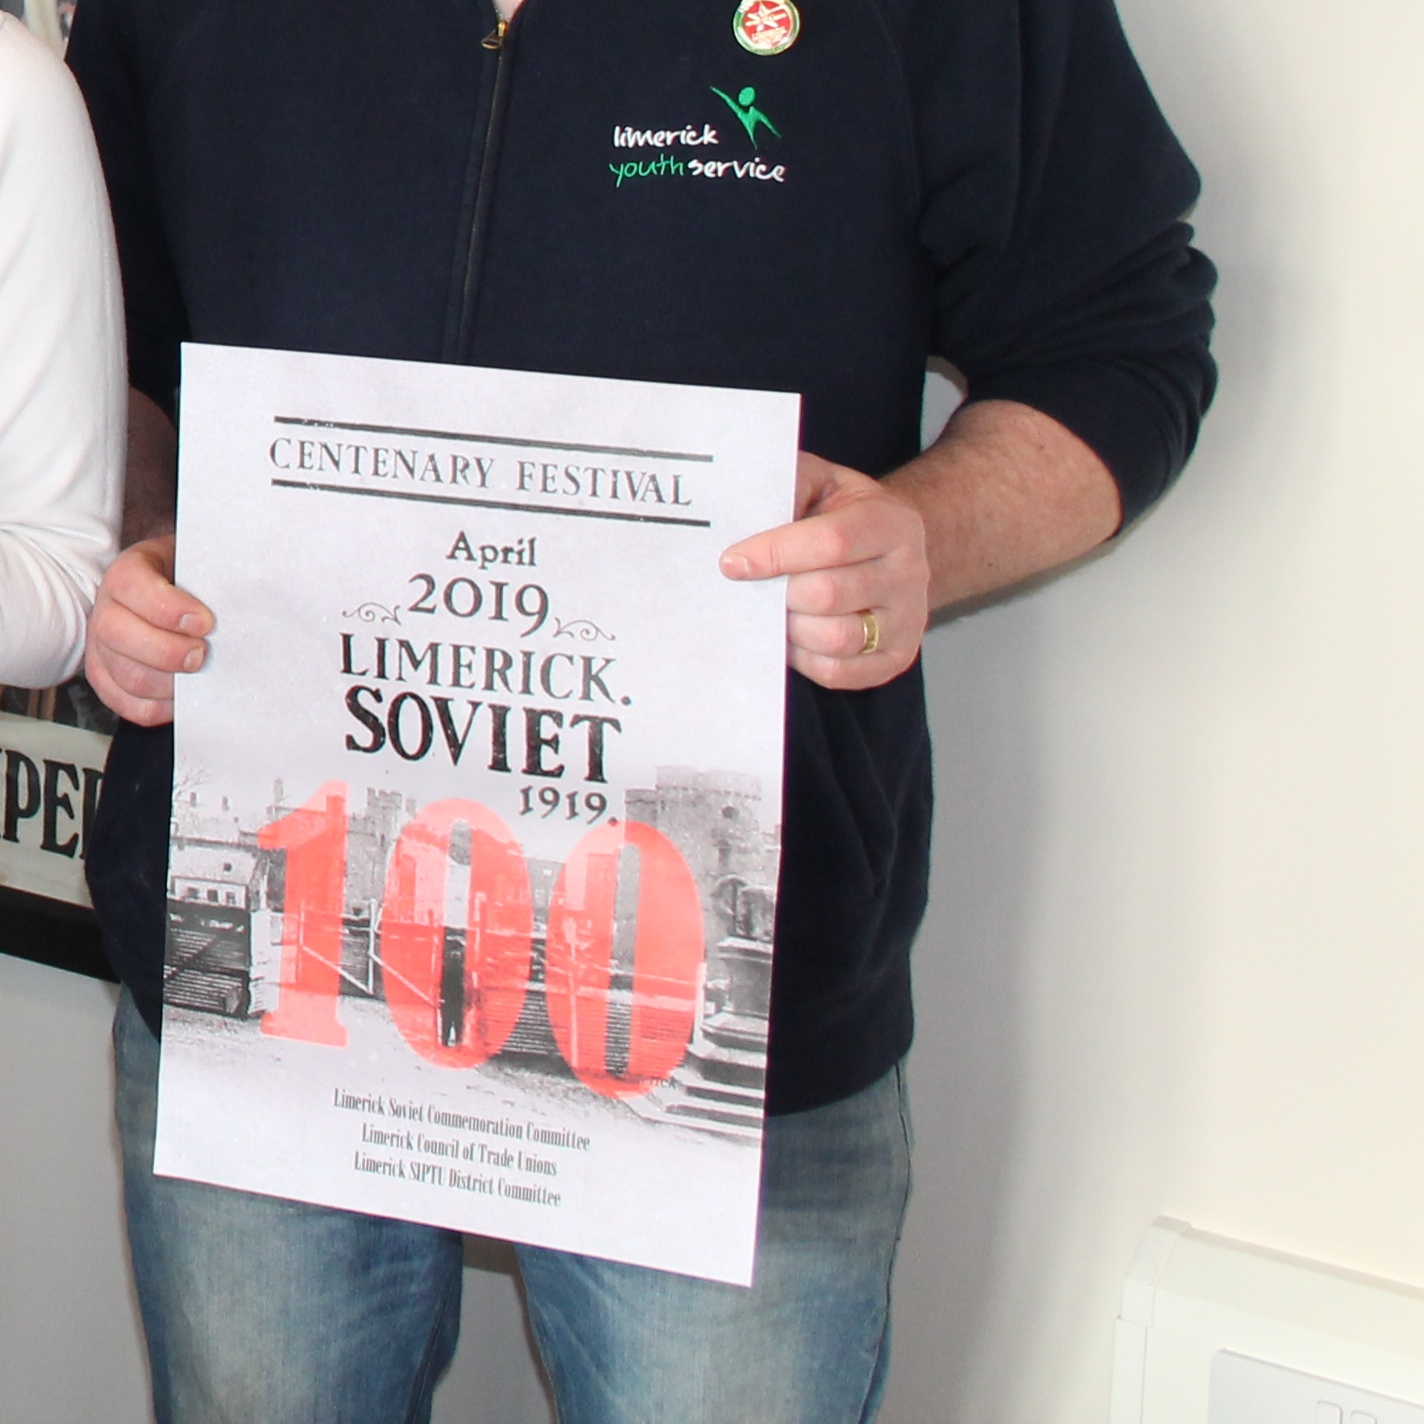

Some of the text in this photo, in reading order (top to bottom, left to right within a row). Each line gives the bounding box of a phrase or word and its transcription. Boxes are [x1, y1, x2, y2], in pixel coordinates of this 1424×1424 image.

[613, 124, 719, 149] limerick
[269, 438, 693, 507] CENTENARY FESTIVAL
[446, 530, 538, 570] April
[407, 573, 550, 637] 2019
[344, 685, 623, 784] SOVIET
[257, 780, 705, 1100] 100
[333, 1088, 591, 1151] Limerick Soviet Commemoration Committee
[362, 1123, 558, 1176] Limerick Council of Trade Unions
[354, 1151, 561, 1208] Limerick SIPTU District Committee
